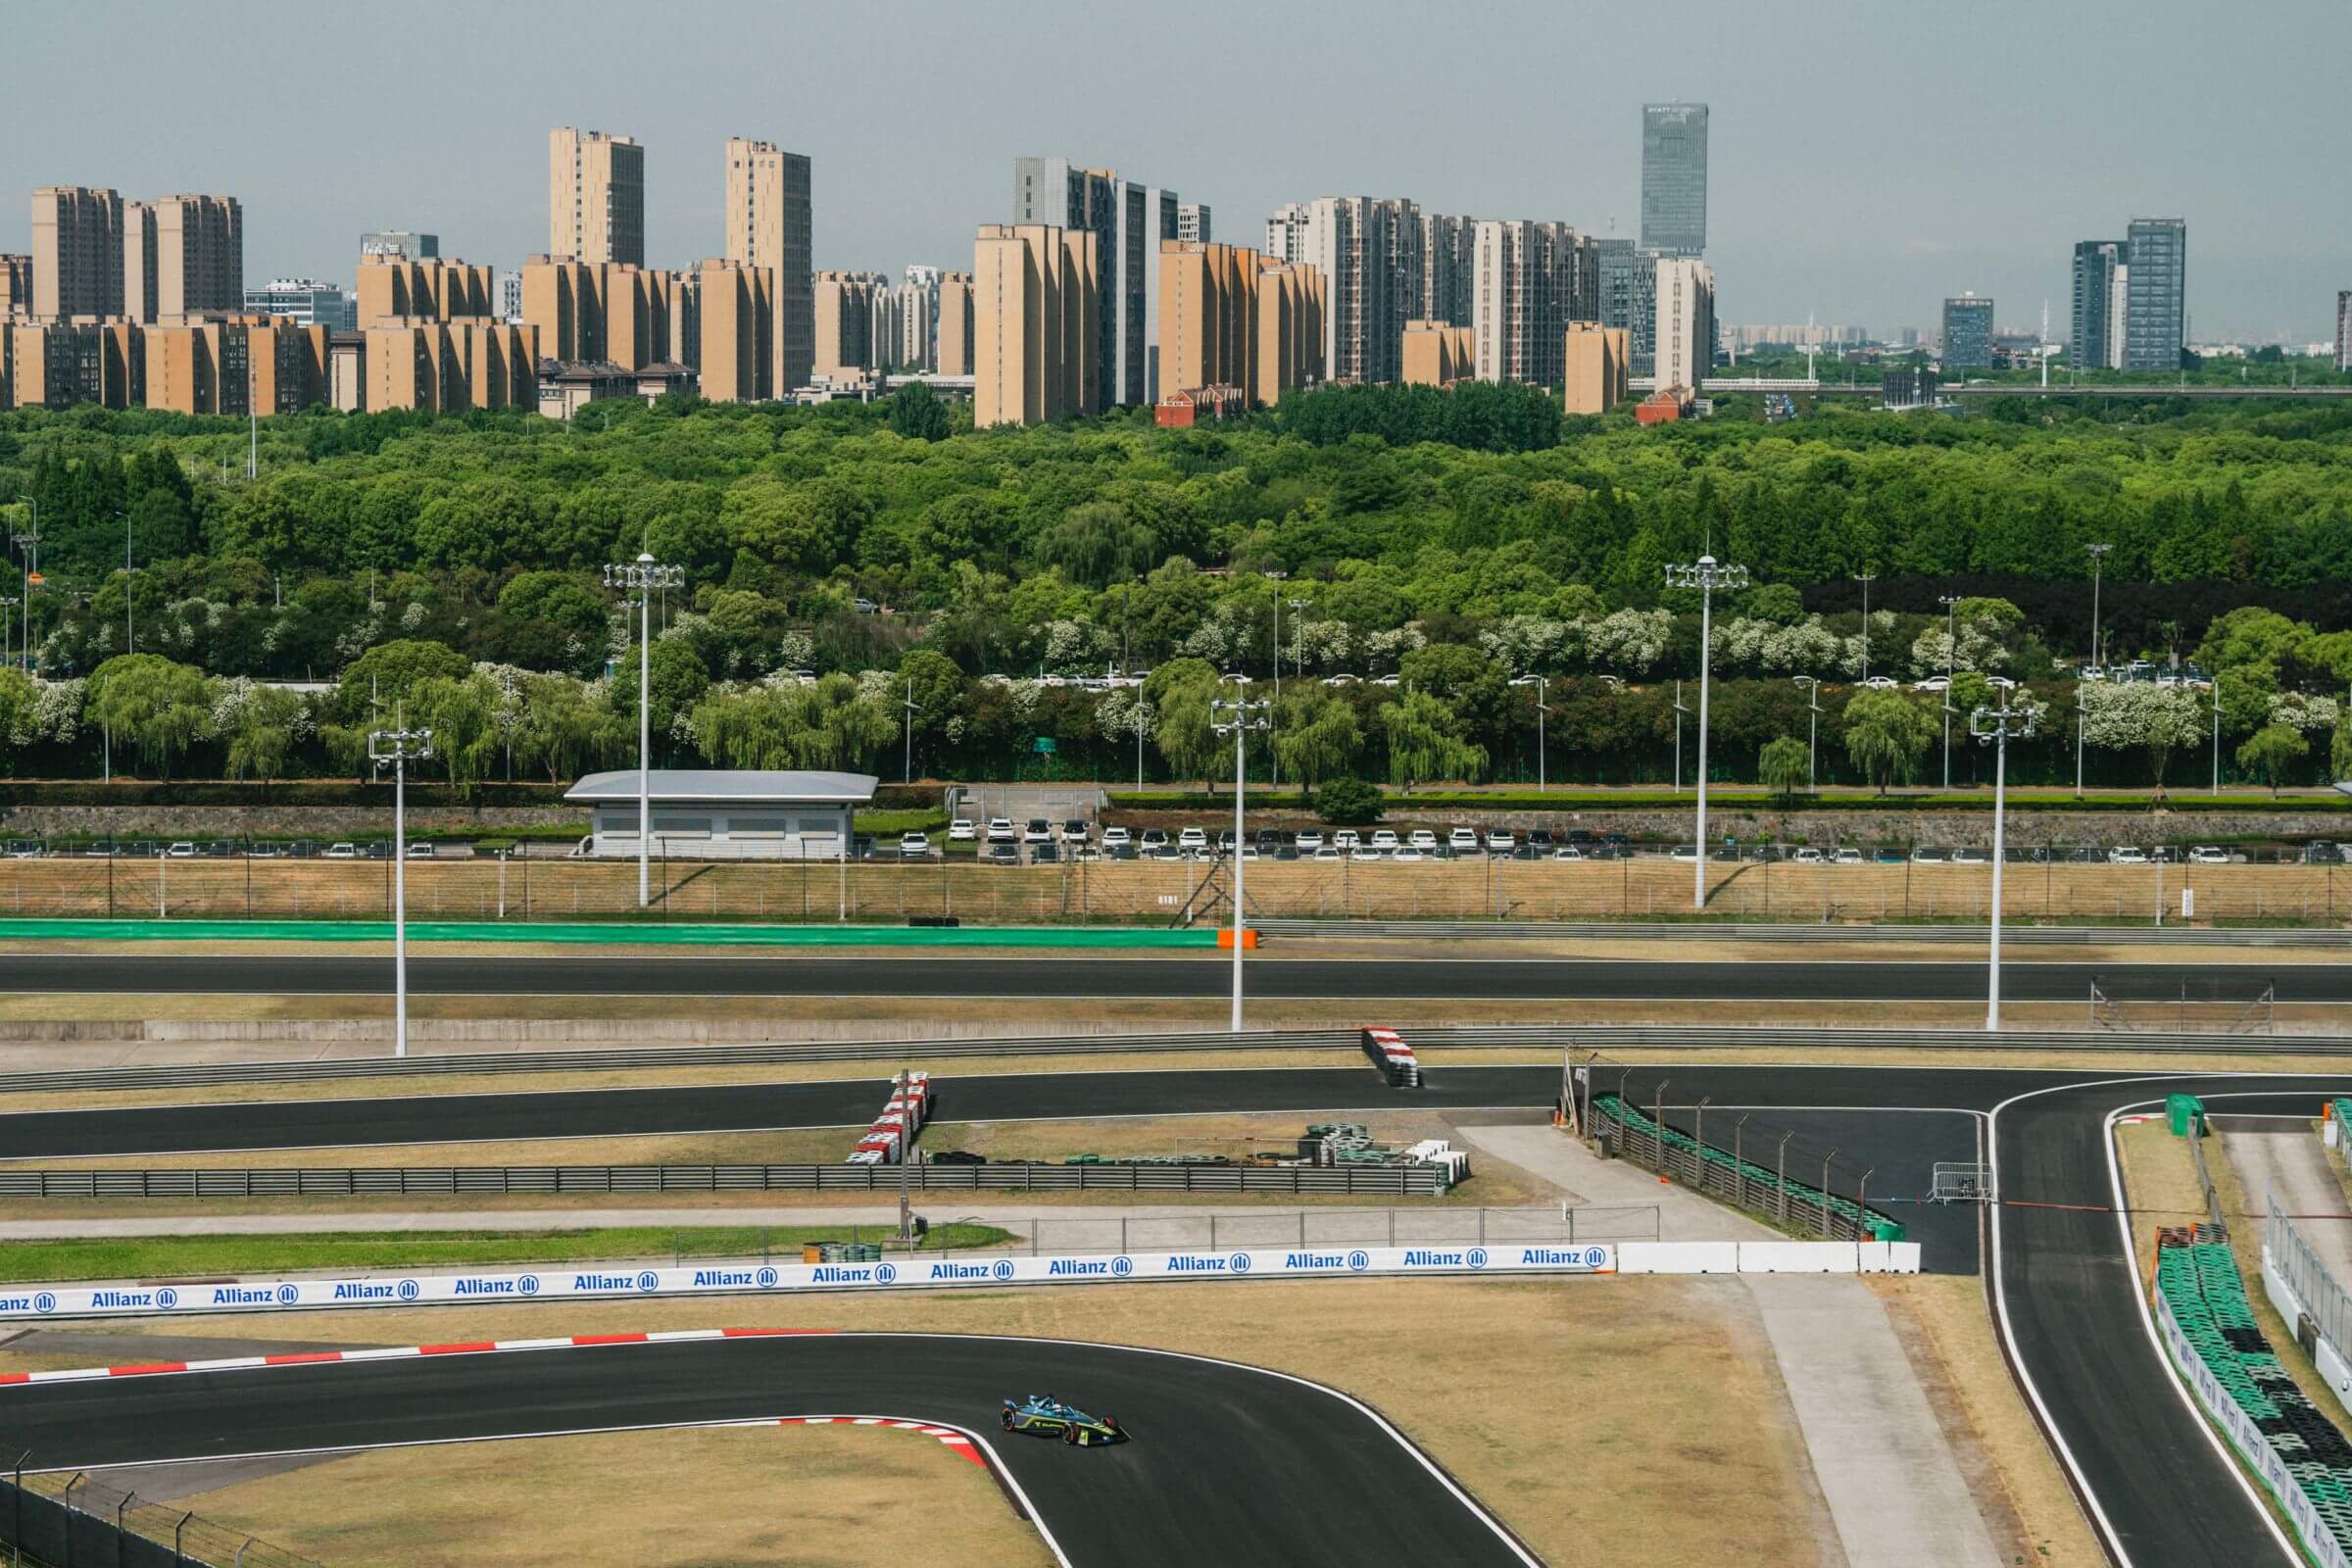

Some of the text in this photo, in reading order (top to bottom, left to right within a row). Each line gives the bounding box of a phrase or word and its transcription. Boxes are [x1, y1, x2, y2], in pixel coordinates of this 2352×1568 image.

[1167, 1255, 1225, 1271] Allianz
[1286, 1252, 1344, 1268] Allianz
[1404, 1250, 1462, 1266] Allianz
[1522, 1249, 1580, 1264] Allianz
[812, 1267, 870, 1283] Allianz
[931, 1263, 989, 1279] Allianz
[1050, 1259, 1107, 1275] Allianz
[574, 1275, 633, 1290] Allianz
[694, 1270, 752, 1286] Allianz
[334, 1284, 393, 1298] Allianz
[455, 1279, 514, 1294] Allianz
[92, 1292, 151, 1306] Allianz
[214, 1288, 272, 1302] Allianz
